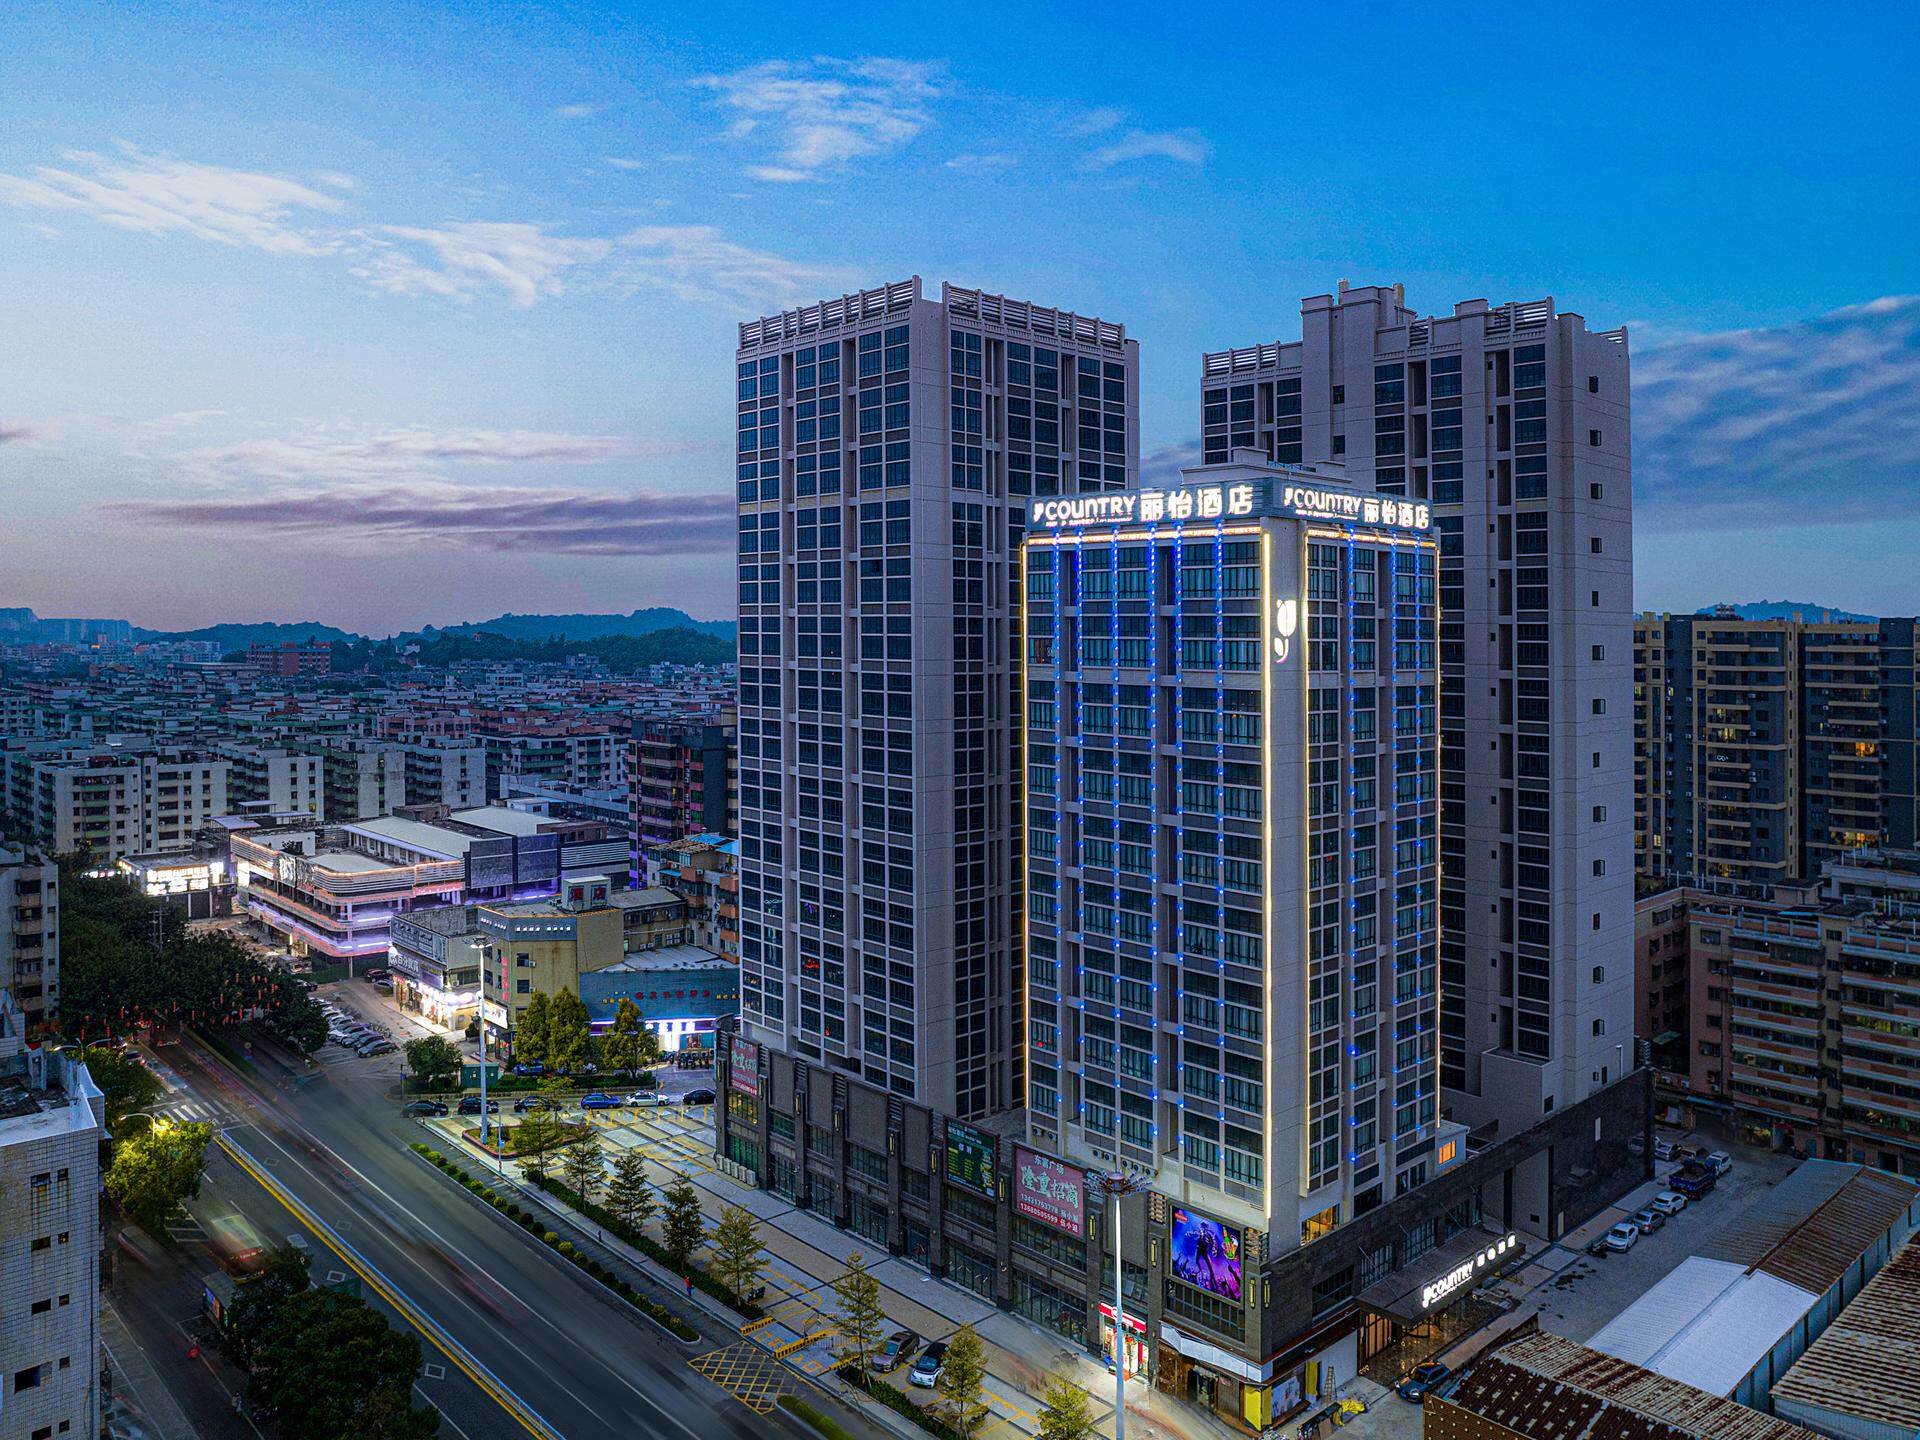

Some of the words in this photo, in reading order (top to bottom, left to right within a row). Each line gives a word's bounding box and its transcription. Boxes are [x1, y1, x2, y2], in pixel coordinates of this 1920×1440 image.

[1045, 495, 1137, 519] COUNTRY
[1140, 485, 1254, 521] 丽怡酒店
[1294, 488, 1363, 514] COUNTRY
[1363, 498, 1430, 530] 丽怡酒店
[1021, 1165, 1078, 1209] 隆重招商
